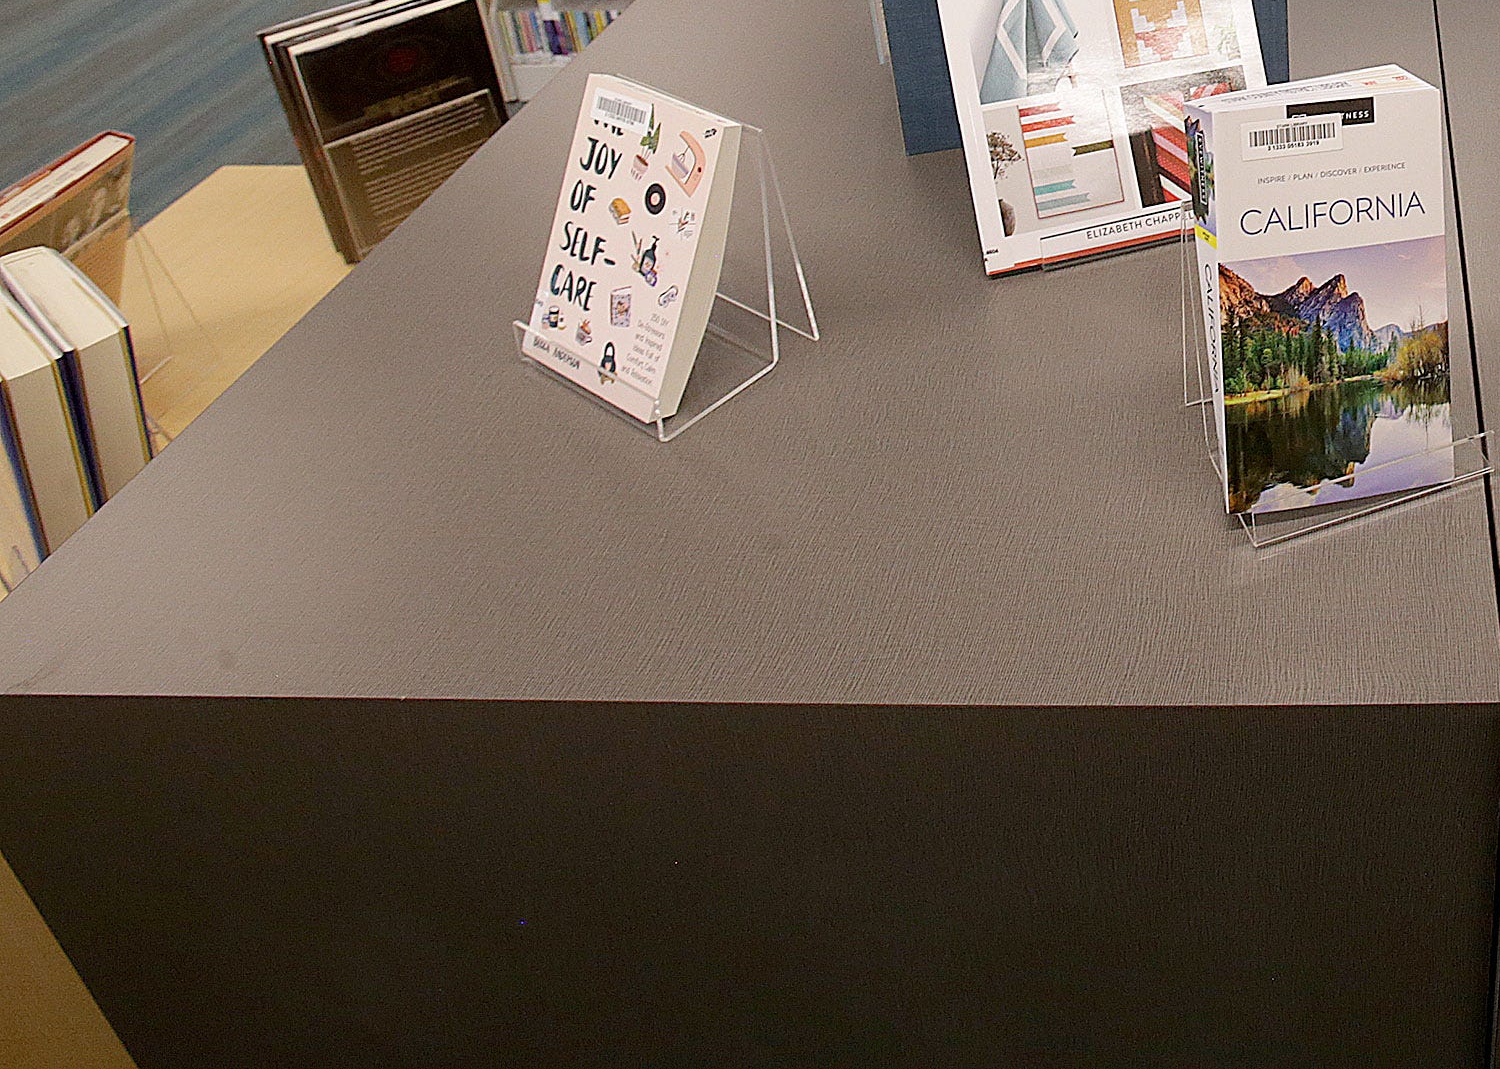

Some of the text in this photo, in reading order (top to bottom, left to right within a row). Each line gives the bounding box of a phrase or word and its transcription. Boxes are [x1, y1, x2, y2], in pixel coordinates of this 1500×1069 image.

[579, 136, 623, 179] JOY
[1257, 161, 1406, 185] INSPIRE PLAN DISCOVER EXPERIENCE
[570, 179, 597, 213] OF
[1240, 191, 1426, 236] CALIFORNIA
[559, 220, 616, 265] SELF-
[1086, 210, 1194, 240] ELIZABETH CHAPPEL
[551, 264, 597, 311] CARE
[1204, 263, 1219, 393] CALIFORNIA
